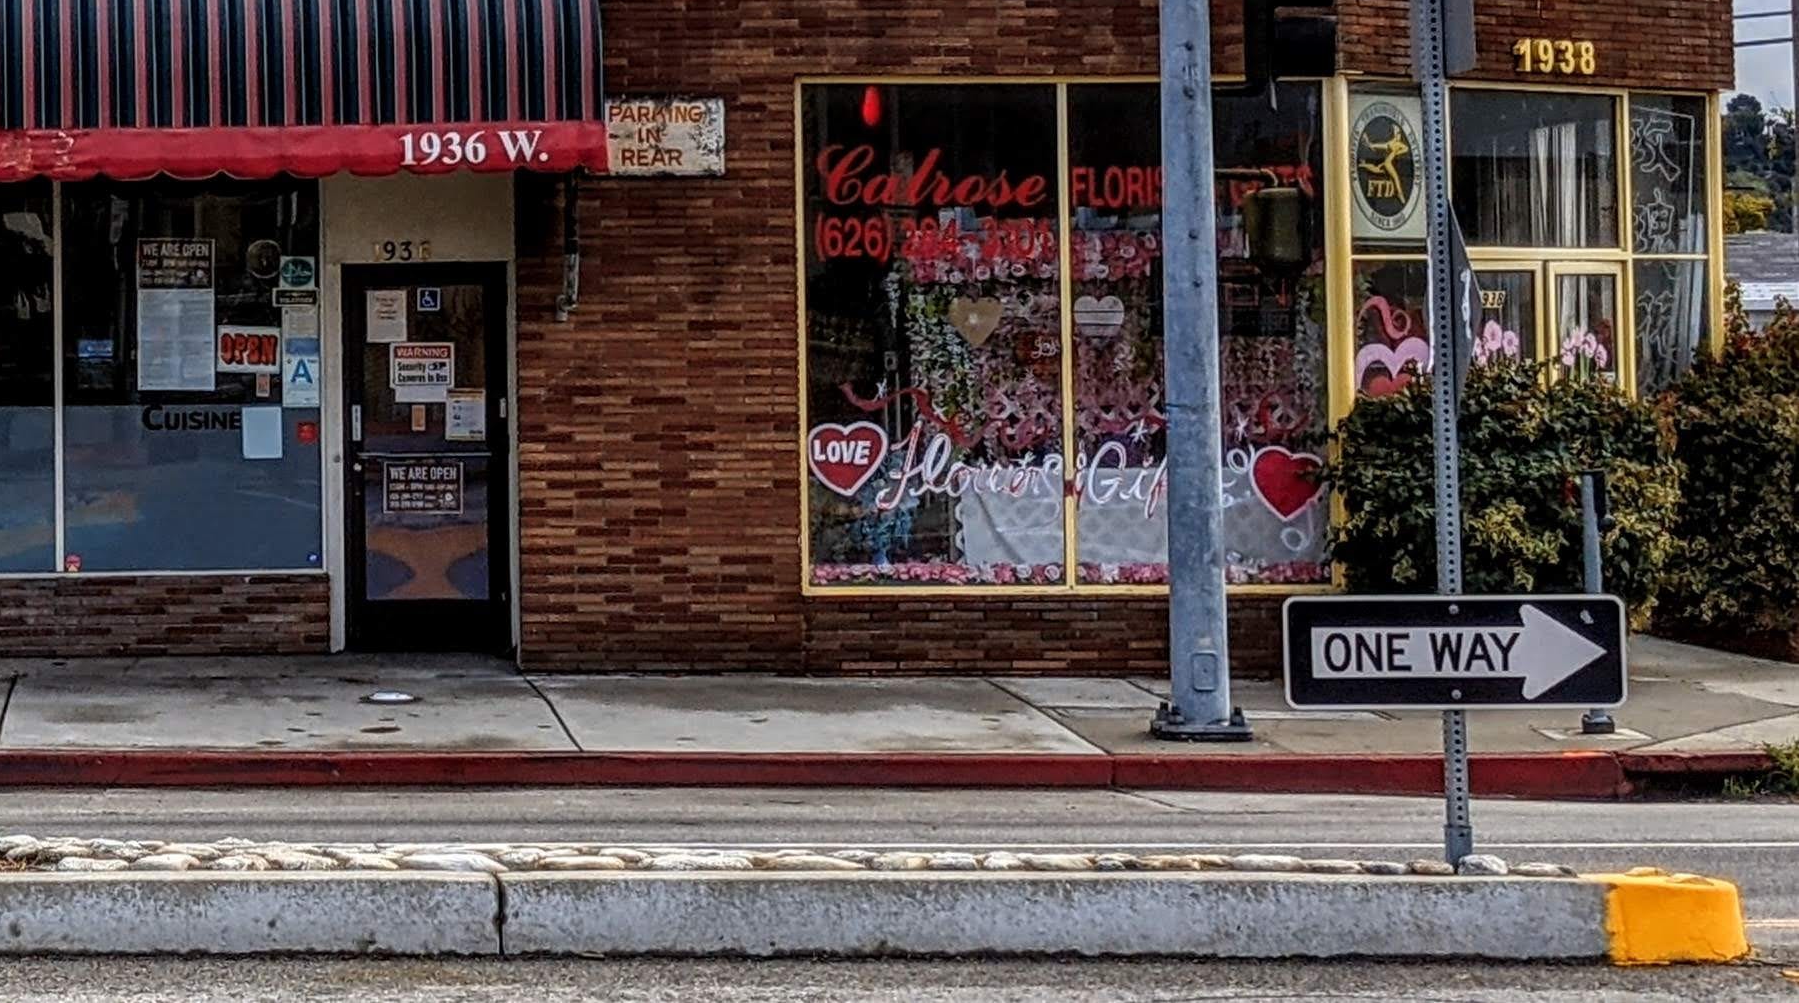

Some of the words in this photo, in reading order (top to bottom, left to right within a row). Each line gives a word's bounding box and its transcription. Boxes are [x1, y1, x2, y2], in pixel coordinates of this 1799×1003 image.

[1516, 38, 1596, 74] 1938
[608, 105, 703, 123] PARKING
[399, 130, 486, 166] 1936
[499, 129, 549, 162] W.
[621, 148, 683, 167] REAR
[816, 144, 1047, 206] Calrose
[1072, 165, 1164, 209] FLORI
[1366, 179, 1395, 198] FTD
[182, 243, 209, 257] OPEN
[815, 210, 892, 263] (626)
[1481, 292, 1505, 307] 938
[220, 332, 278, 366] OPEN
[396, 348, 448, 358] WARNING
[290, 358, 314, 384] A
[812, 438, 872, 466] LOVE
[407, 466, 428, 480] ARE
[430, 466, 457, 480] OPEN
[1323, 632, 1413, 673] ONE
[1428, 632, 1520, 673] WAY
